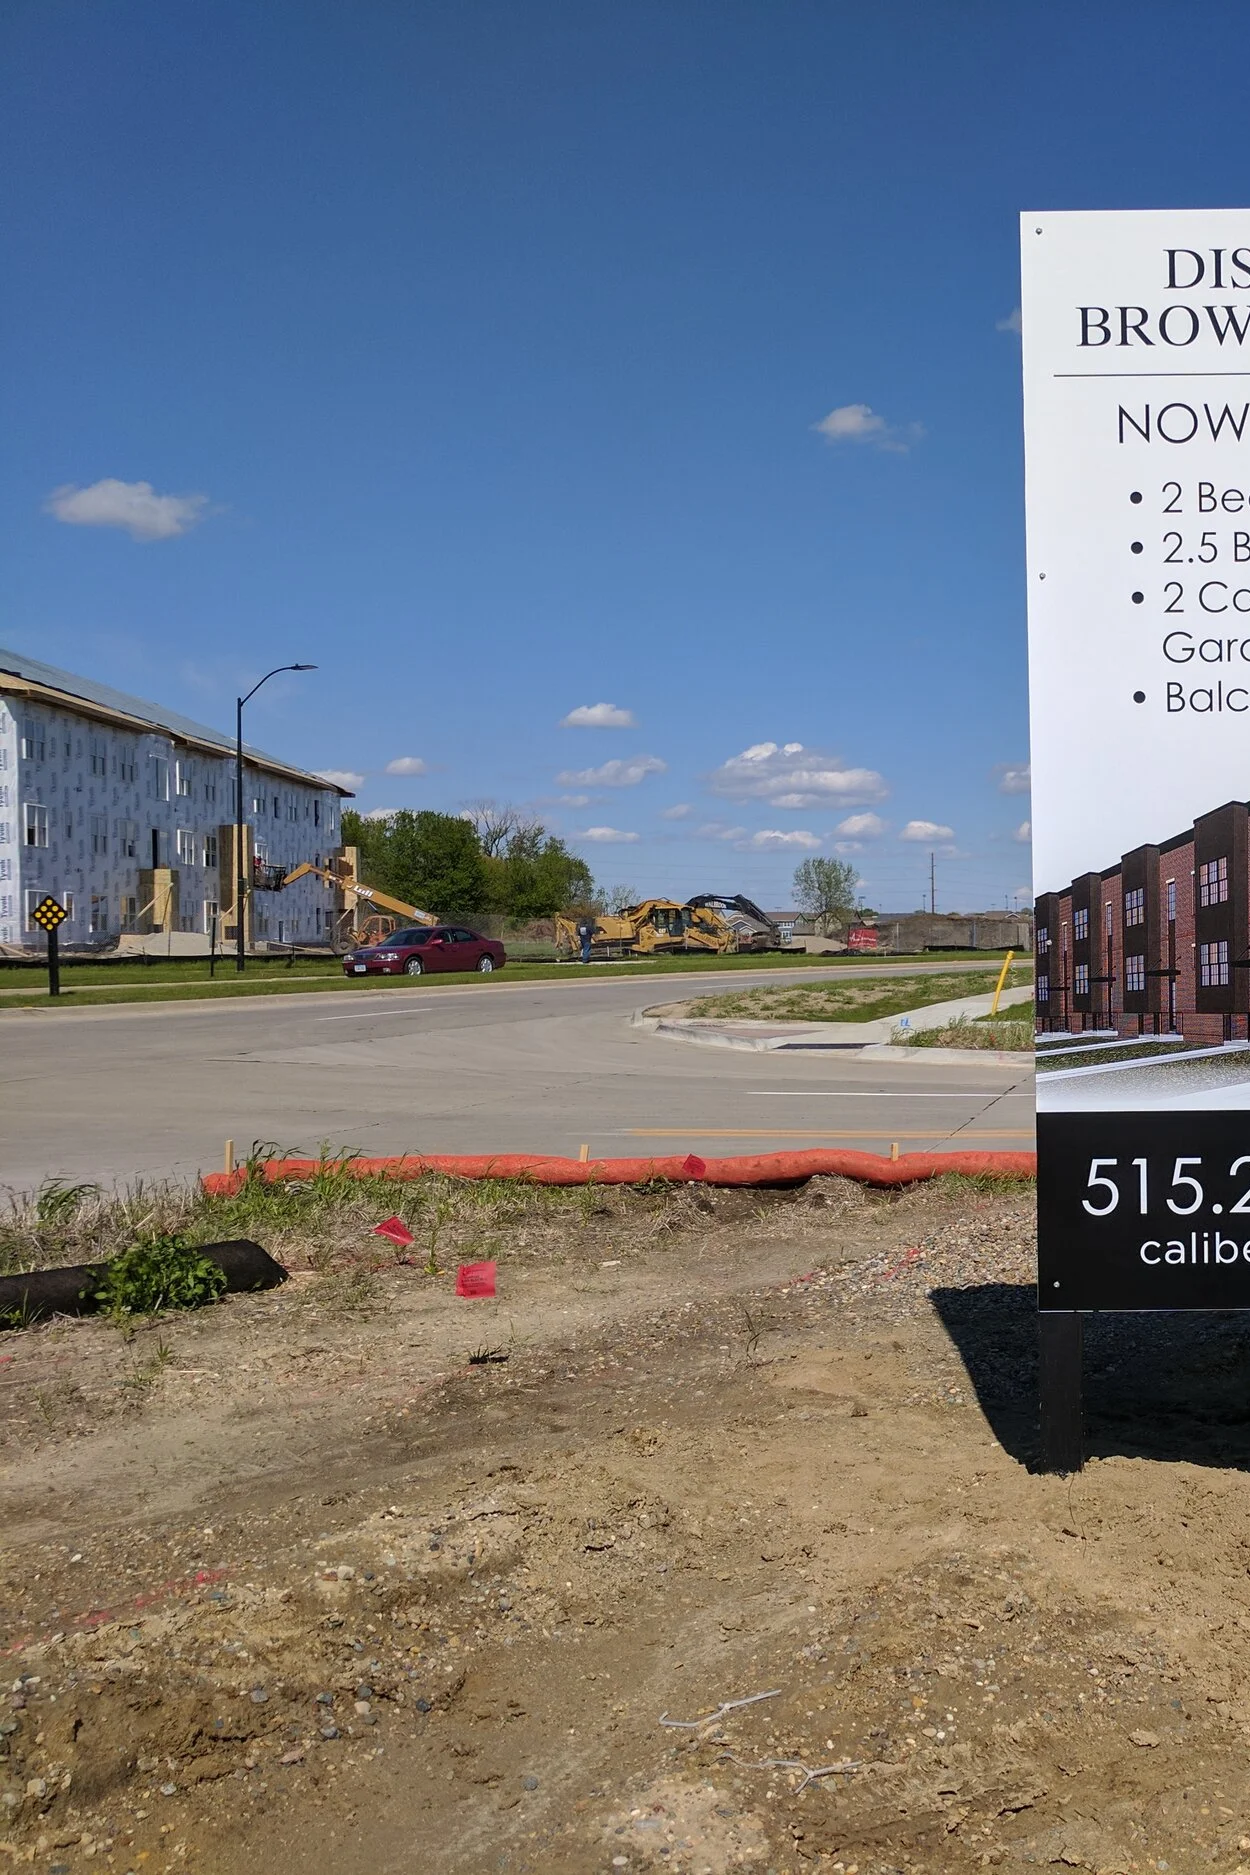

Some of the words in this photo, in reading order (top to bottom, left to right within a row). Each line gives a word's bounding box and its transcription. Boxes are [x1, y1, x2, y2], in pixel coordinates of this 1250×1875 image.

[1118, 402, 1250, 444] NOW
[1161, 481, 1184, 514] 2
[1162, 531, 1218, 564] 2.5
[1162, 581, 1185, 614] 2
